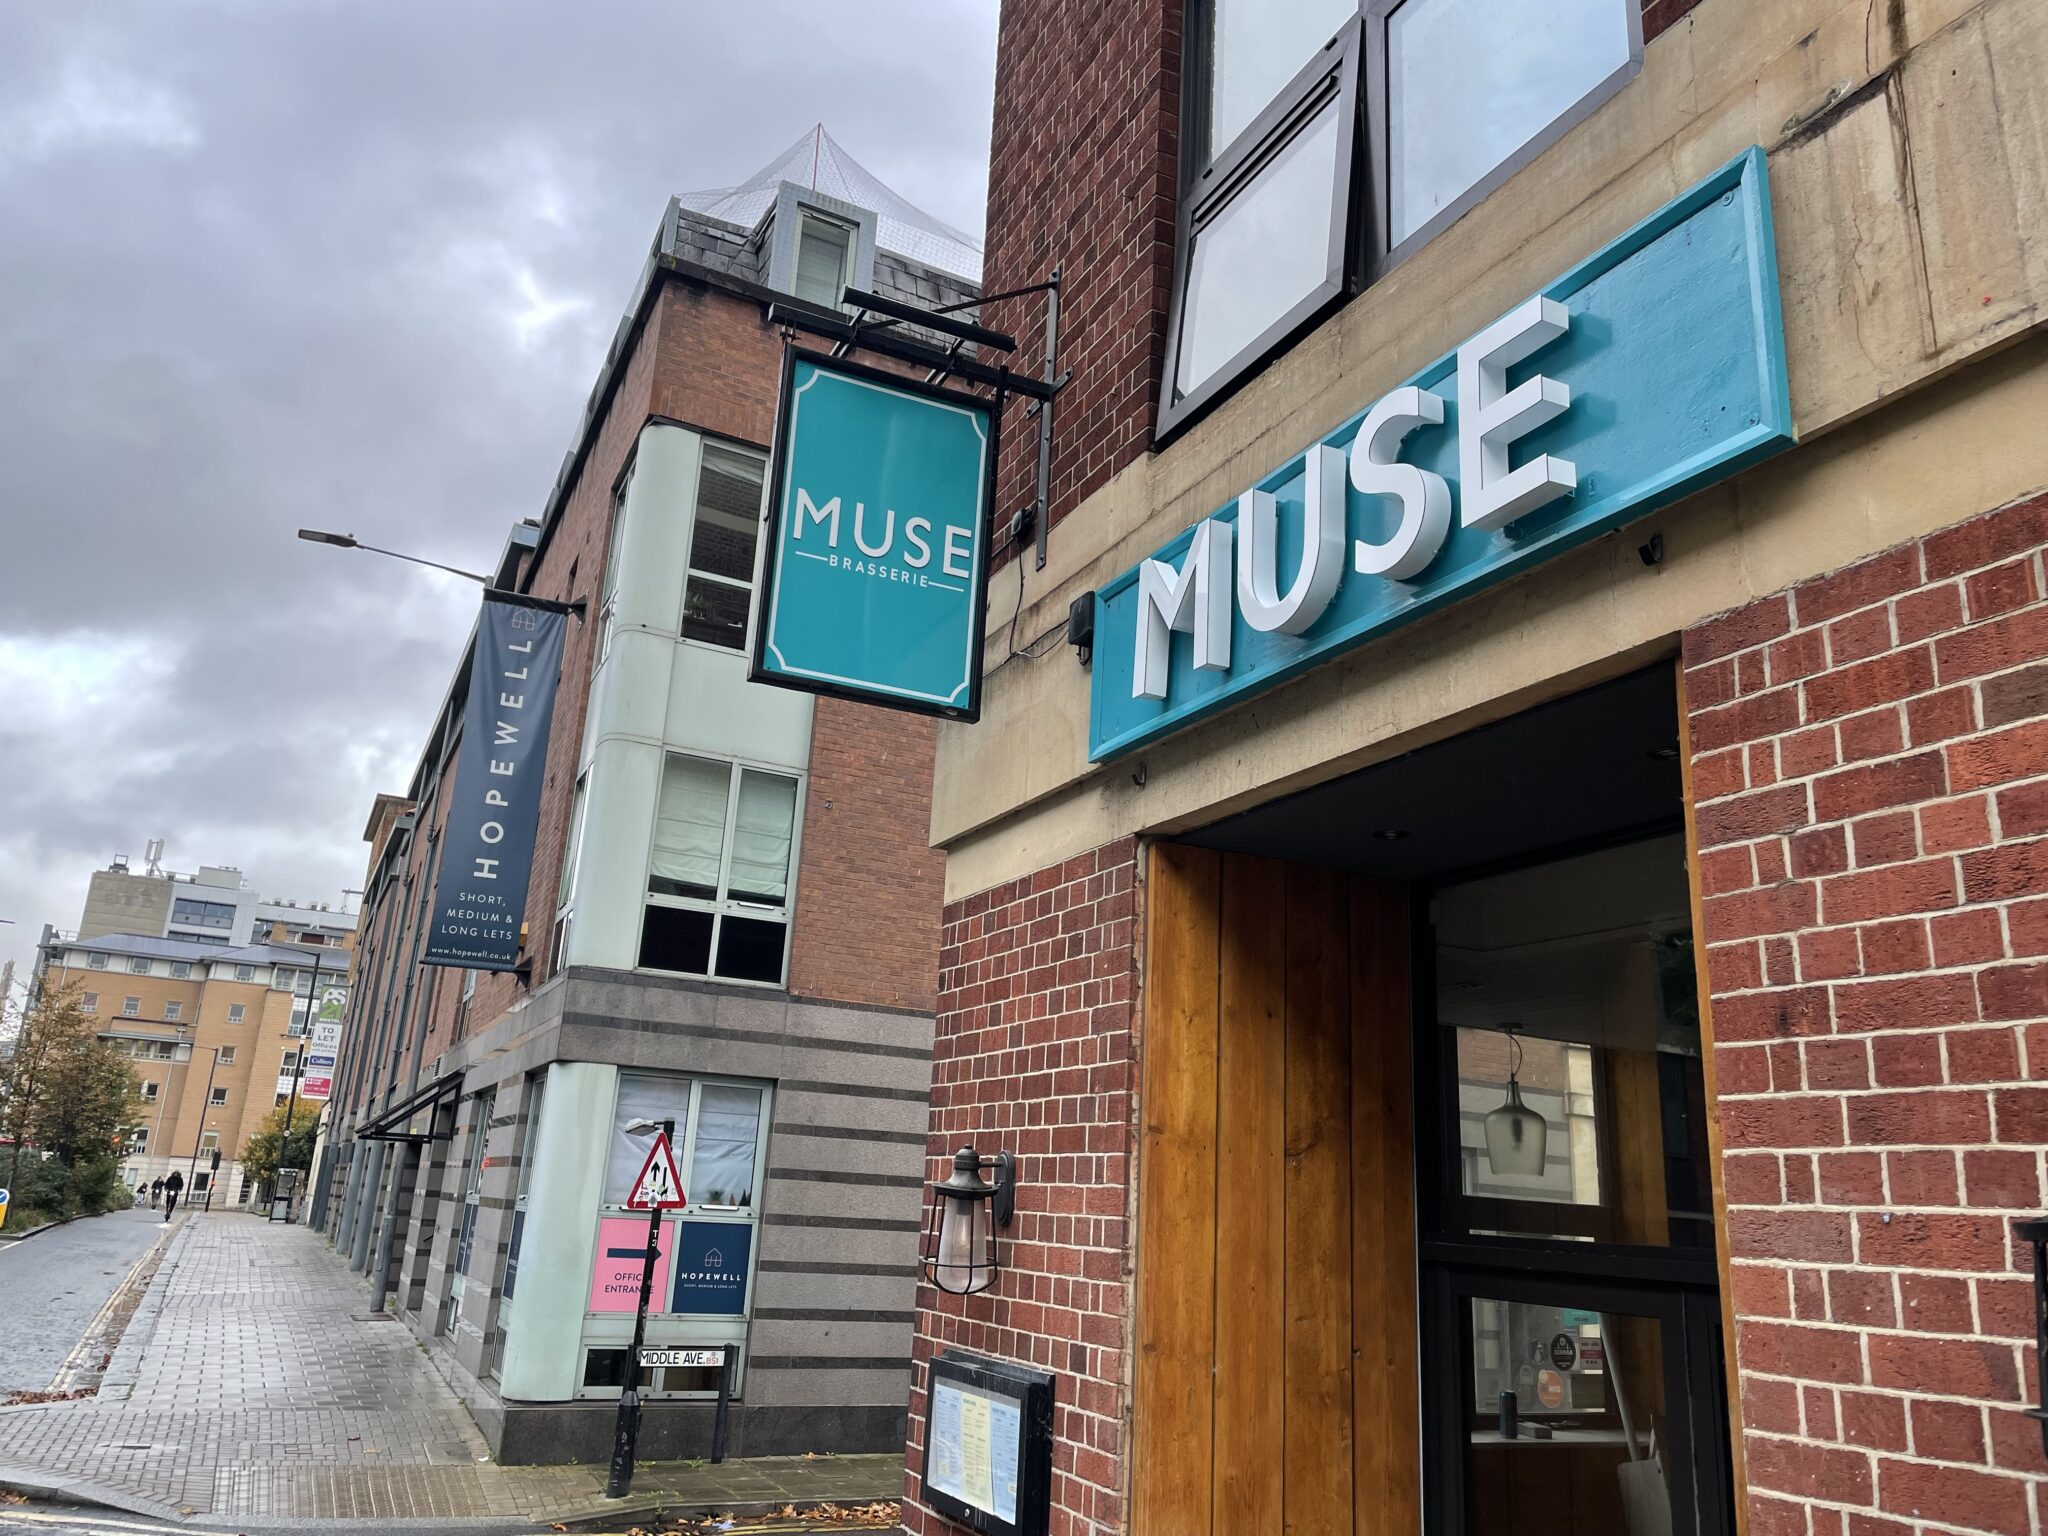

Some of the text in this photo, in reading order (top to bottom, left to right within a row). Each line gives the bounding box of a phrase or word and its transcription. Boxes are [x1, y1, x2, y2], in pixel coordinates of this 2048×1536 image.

[1131, 294, 1577, 699] MUSE
[793, 487, 973, 579] MUSE
[829, 554, 929, 588] BRASSERIE
[473, 640, 532, 879] HOPEWELL
[459, 892, 506, 907] SHORT,
[446, 908, 500, 922] MEDIUM
[441, 924, 513, 940] LONG LETS
[431, 947, 511, 961] www.hopewell.co.uk
[317, 1034, 336, 1042] LET
[312, 1042, 338, 1050] Offices
[614, 1272, 643, 1282] OFFIC
[681, 1272, 742, 1281] HOPEWELL
[604, 1284, 654, 1294] ENTRANE
[640, 1352, 680, 1365] MIDDLE
[682, 1352, 706, 1365] AVE.
